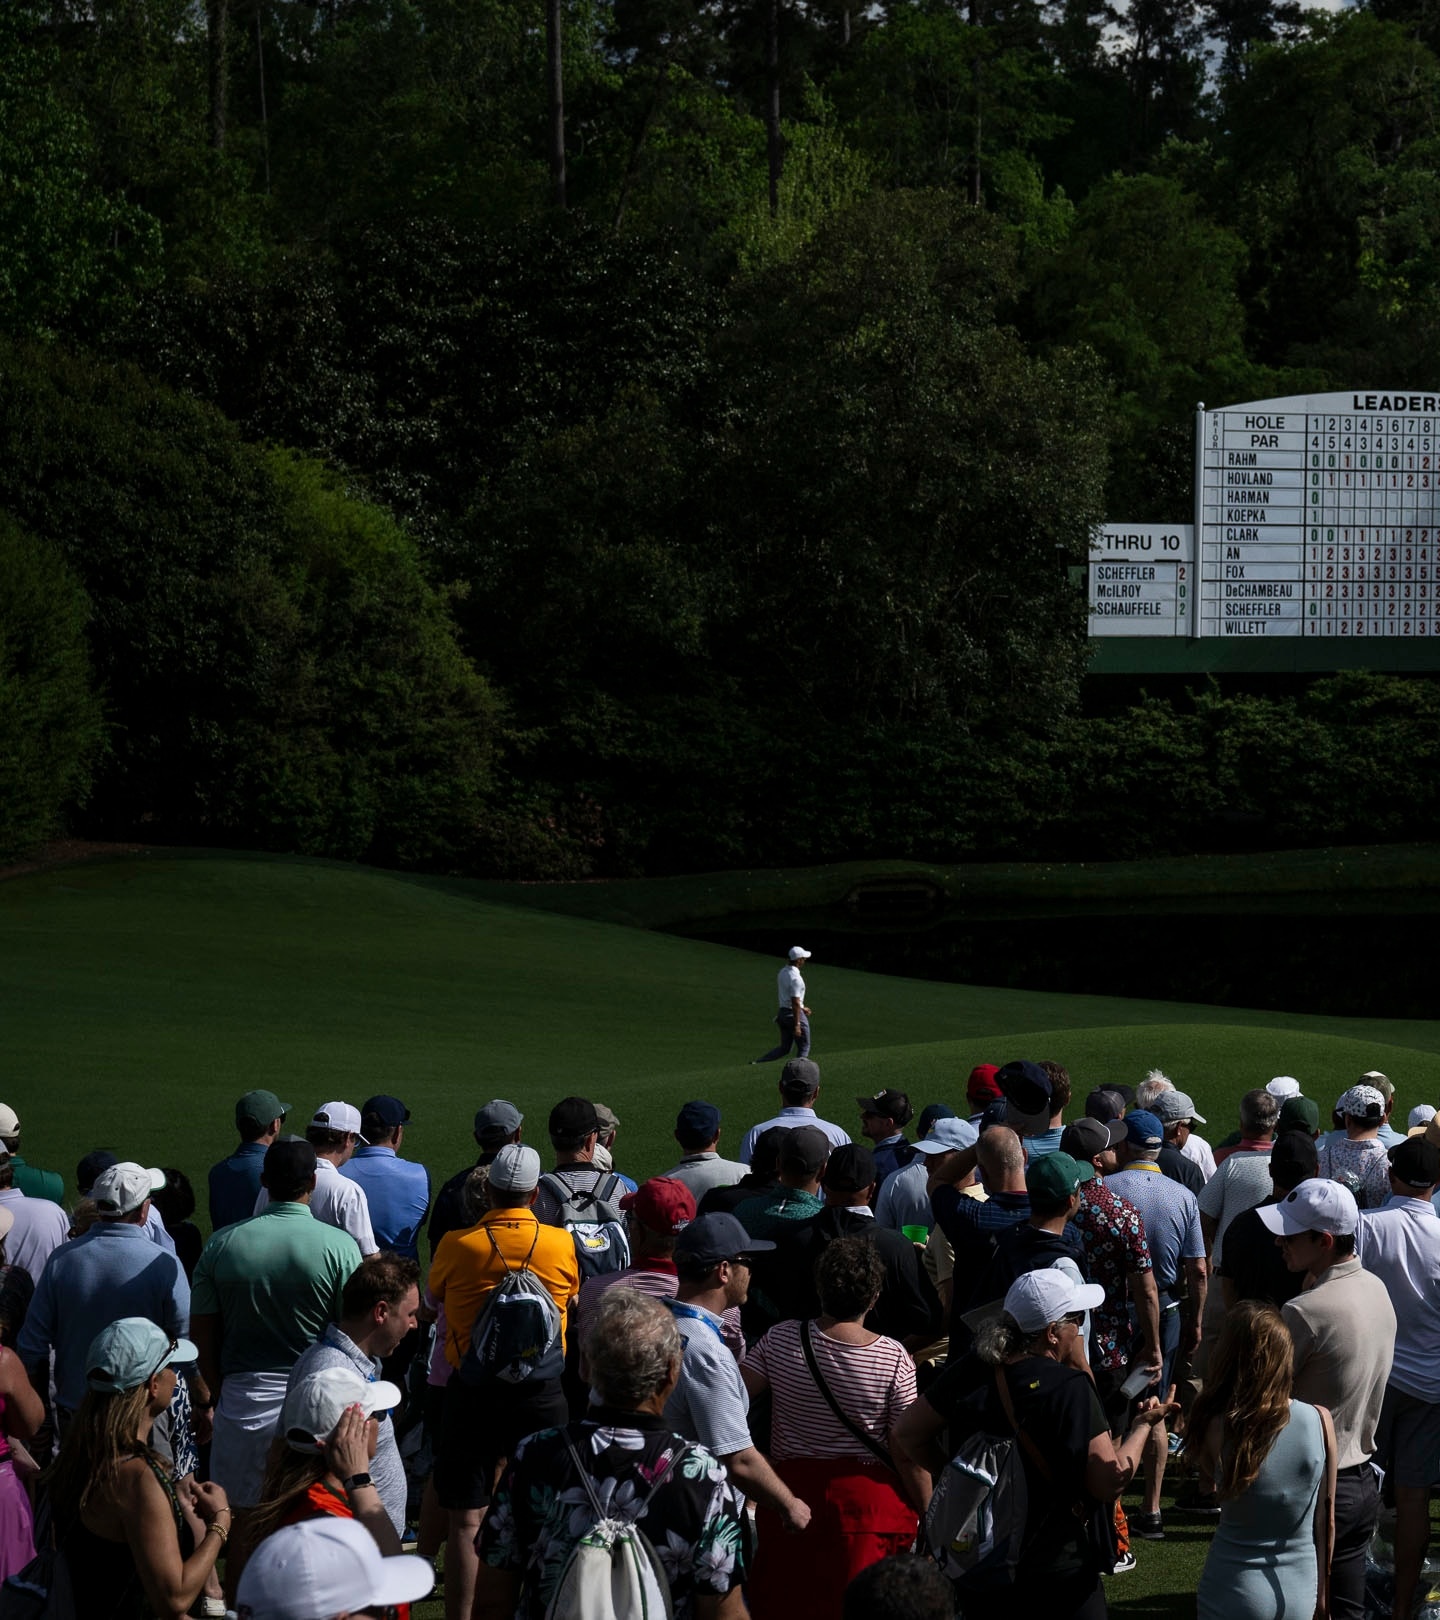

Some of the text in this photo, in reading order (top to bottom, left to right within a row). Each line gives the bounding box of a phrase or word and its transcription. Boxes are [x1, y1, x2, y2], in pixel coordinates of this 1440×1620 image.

[1245, 416, 1285, 429] HOLE
[1329, 418, 1336, 431] 2
[1344, 418, 1351, 431] 3
[1360, 419, 1367, 432] 4
[1376, 419, 1383, 432] 5
[1392, 419, 1399, 432] 6
[1408, 420, 1415, 432] 7
[1423, 420, 1430, 433] 8
[1251, 435, 1279, 447] PAR
[1312, 436, 1319, 448] 4
[1328, 436, 1336, 449] 5
[1344, 437, 1351, 450] 4
[1360, 437, 1367, 450] 3
[1376, 438, 1383, 450] 4
[1392, 437, 1398, 451] 3
[1407, 438, 1414, 451] 4
[1423, 438, 1430, 451] 5
[1228, 453, 1257, 466] RAHM
[1312, 454, 1319, 467] 0
[1328, 454, 1335, 467] 0
[1360, 455, 1367, 468] 0
[1376, 456, 1383, 468] 0
[1391, 456, 1398, 469] 0
[1423, 456, 1430, 469] 2
[1228, 472, 1272, 485] HOVLAND
[1312, 473, 1319, 486] 0
[1407, 474, 1414, 487] 2
[1422, 475, 1429, 488] 3
[1228, 491, 1319, 504] HARMAN 0
[1228, 509, 1266, 522] KOEPKA
[1104, 535, 1180, 550] THRU 10
[1227, 528, 1258, 541] CLARK
[1311, 528, 1318, 542] 0
[1327, 529, 1334, 542] 0
[1406, 530, 1412, 543] 2
[1421, 530, 1428, 543] 2
[1226, 547, 1240, 560] AN
[1327, 547, 1334, 560] 2
[1343, 548, 1350, 560] 3
[1359, 548, 1365, 561] 3
[1374, 548, 1381, 561] 2
[1390, 548, 1396, 561] 3
[1406, 548, 1412, 561] 3
[1421, 549, 1426, 561] 4
[1098, 566, 1185, 580] SCHEFFLER 2
[1226, 565, 1245, 578] FOX
[1326, 566, 1334, 579] 2
[1342, 566, 1349, 579] 3
[1358, 566, 1365, 579] 3
[1374, 566, 1380, 579] 3
[1389, 566, 1396, 579] 3
[1405, 566, 1412, 579] 3
[1420, 566, 1427, 579] 5
[1097, 585, 1186, 598] McILROY 0
[1226, 584, 1292, 597] DeCHAMBEAU
[1326, 584, 1333, 597] 2
[1342, 585, 1348, 598] 3
[1358, 585, 1364, 598] 3
[1373, 585, 1380, 598] 3
[1389, 584, 1395, 598] 3
[1404, 585, 1410, 598] 3
[1420, 585, 1426, 598] 3
[1096, 603, 1185, 615] SCHAUFFELE 2
[1225, 603, 1281, 616] SCHEFFLER
[1310, 603, 1317, 616] 0
[1388, 603, 1395, 616] 2
[1404, 603, 1410, 616] 2
[1419, 603, 1426, 616] 2
[1225, 622, 1267, 634] WILLETT
[1341, 621, 1348, 634] 2
[1356, 621, 1363, 634] 2
[1404, 622, 1410, 634] 2
[1419, 622, 1425, 634] 3
[1435, 621, 1440, 634] 3
